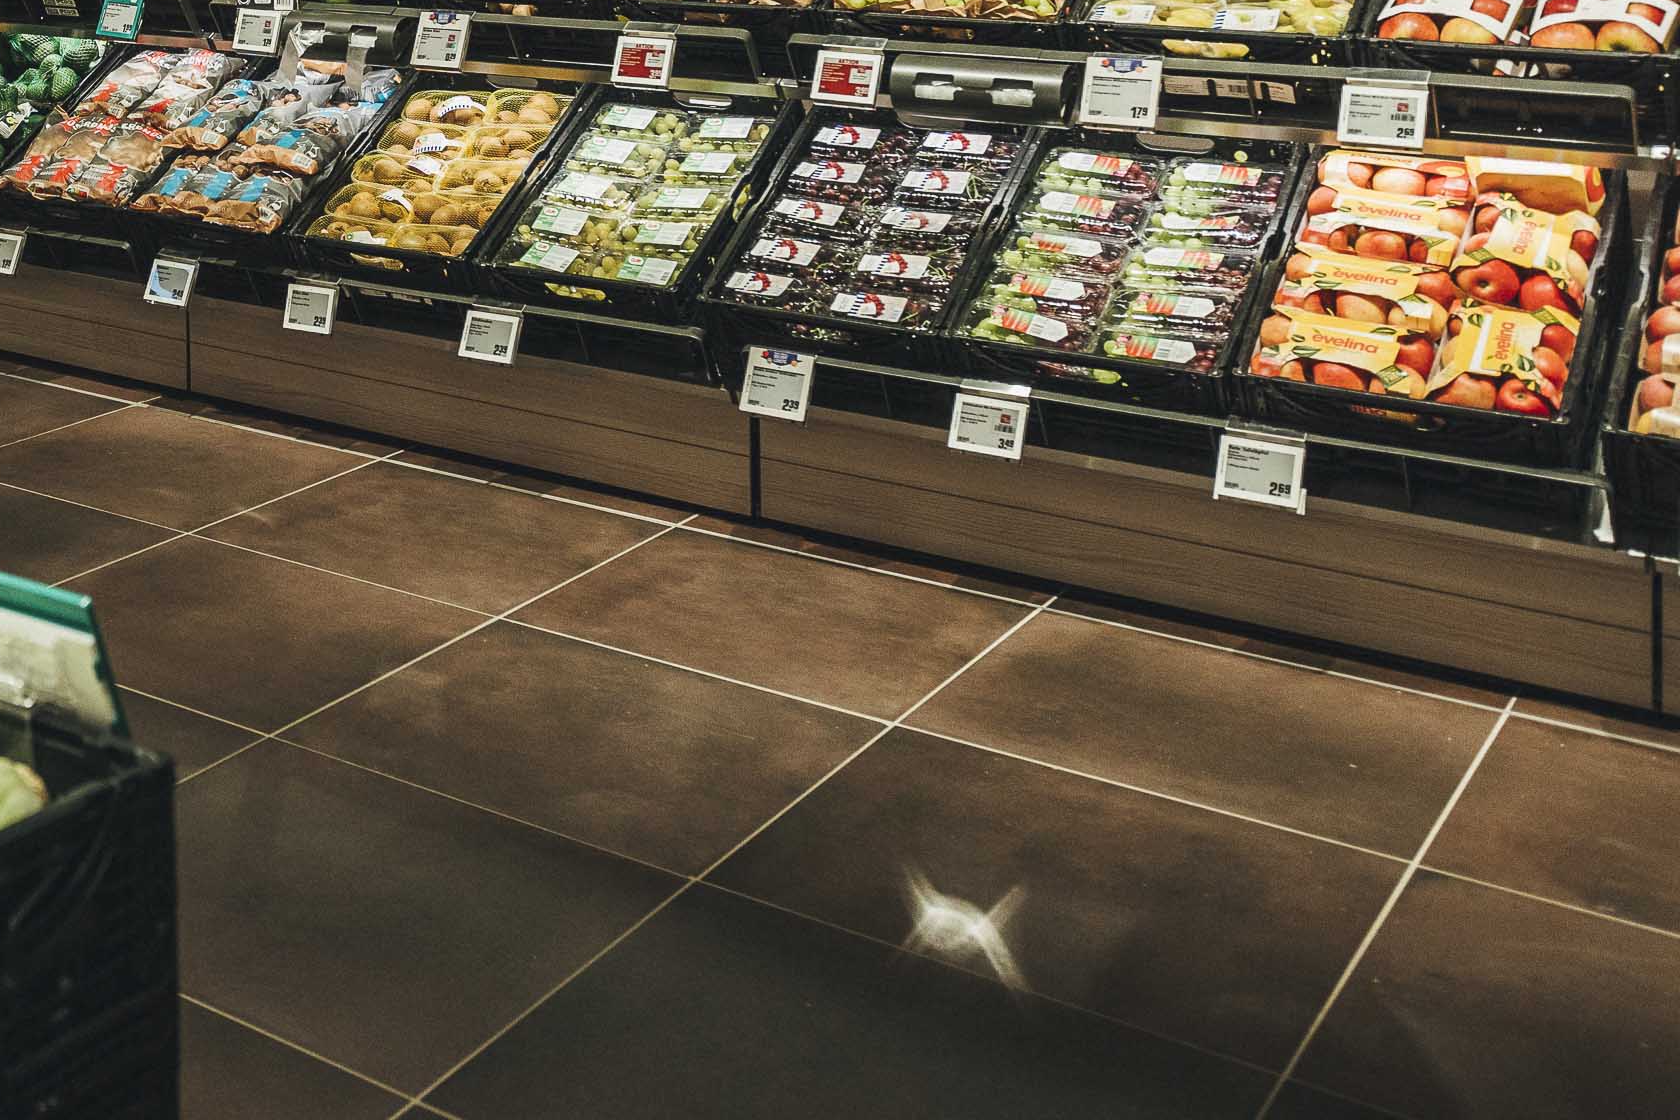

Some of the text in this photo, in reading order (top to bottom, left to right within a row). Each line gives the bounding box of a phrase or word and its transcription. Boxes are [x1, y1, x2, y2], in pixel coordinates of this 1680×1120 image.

[1131, 106, 1149, 119] 1.79
[1396, 127, 1415, 139] 2.69
[781, 398, 800, 412] 2.39
[1268, 482, 1291, 497] 2.69
